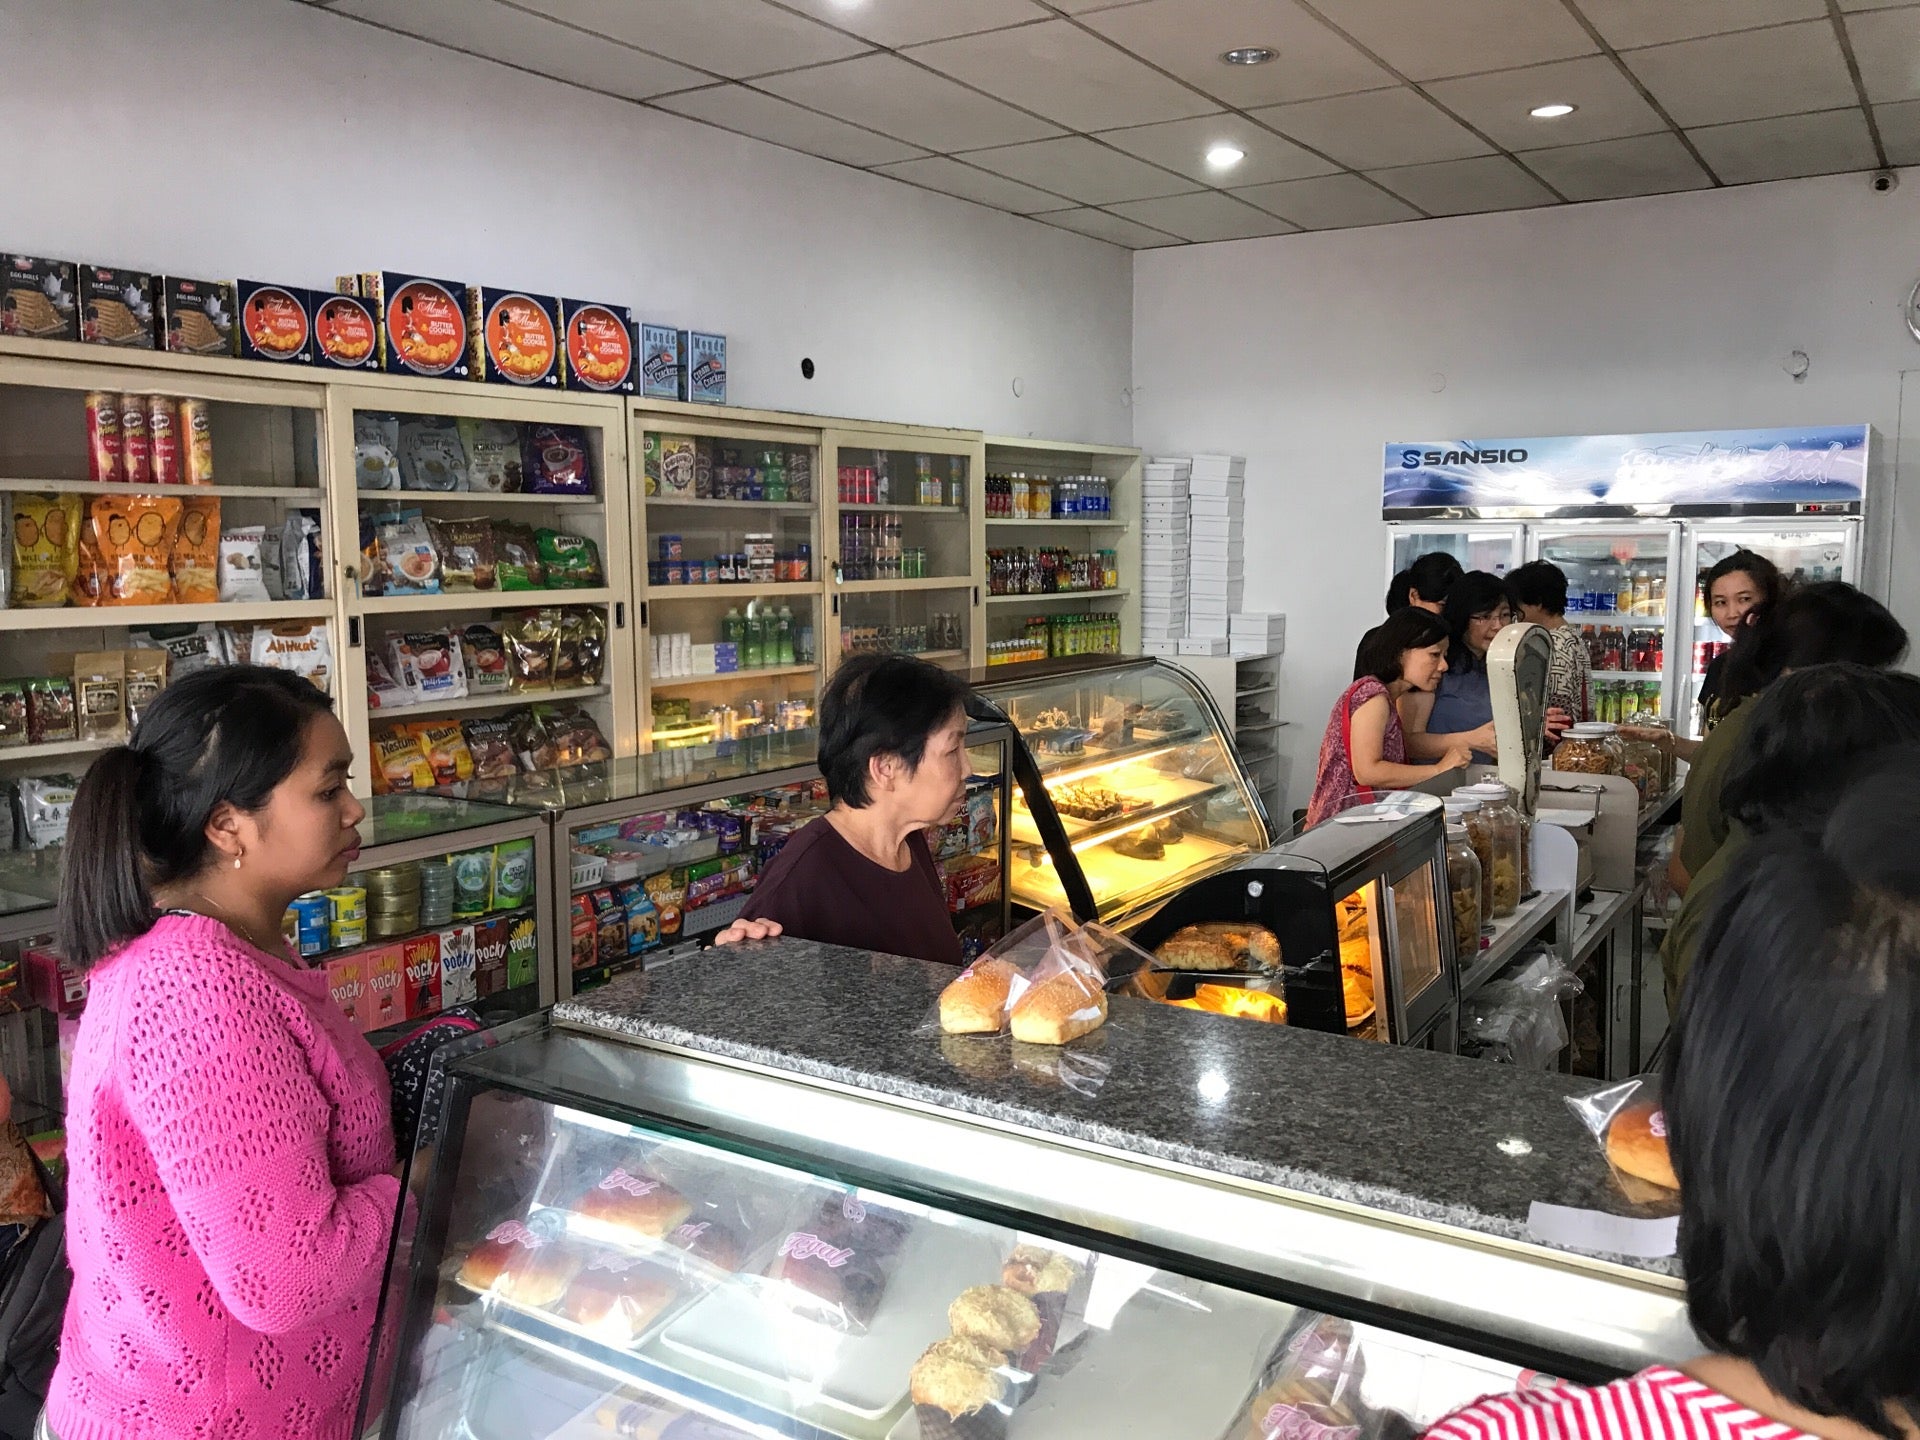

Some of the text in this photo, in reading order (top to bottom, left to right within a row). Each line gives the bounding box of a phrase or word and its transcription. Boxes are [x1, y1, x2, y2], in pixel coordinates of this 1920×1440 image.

[22, 273, 39, 281] ROLLS
[418, 302, 452, 319] Monde
[430, 321, 453, 329] BUTTER
[515, 313, 543, 331] Monde
[428, 327, 456, 336] COOKIES
[525, 333, 546, 341] BUTTER
[592, 325, 620, 340] Monde
[645, 328, 676, 345] Monde
[522, 339, 547, 348] COOKIES
[601, 341, 621, 349] BUTTER
[694, 337, 725, 352] Monde
[599, 347, 624, 356] COOKIES
[643, 358, 662, 376] Cream
[654, 367, 679, 382] Crackers
[692, 365, 712, 382] Cream
[703, 373, 726, 388] Crackers
[1423, 449, 1528, 466] SANSIO
[557, 537, 583, 549] MILO
[266, 639, 318, 653] Ah Huat
